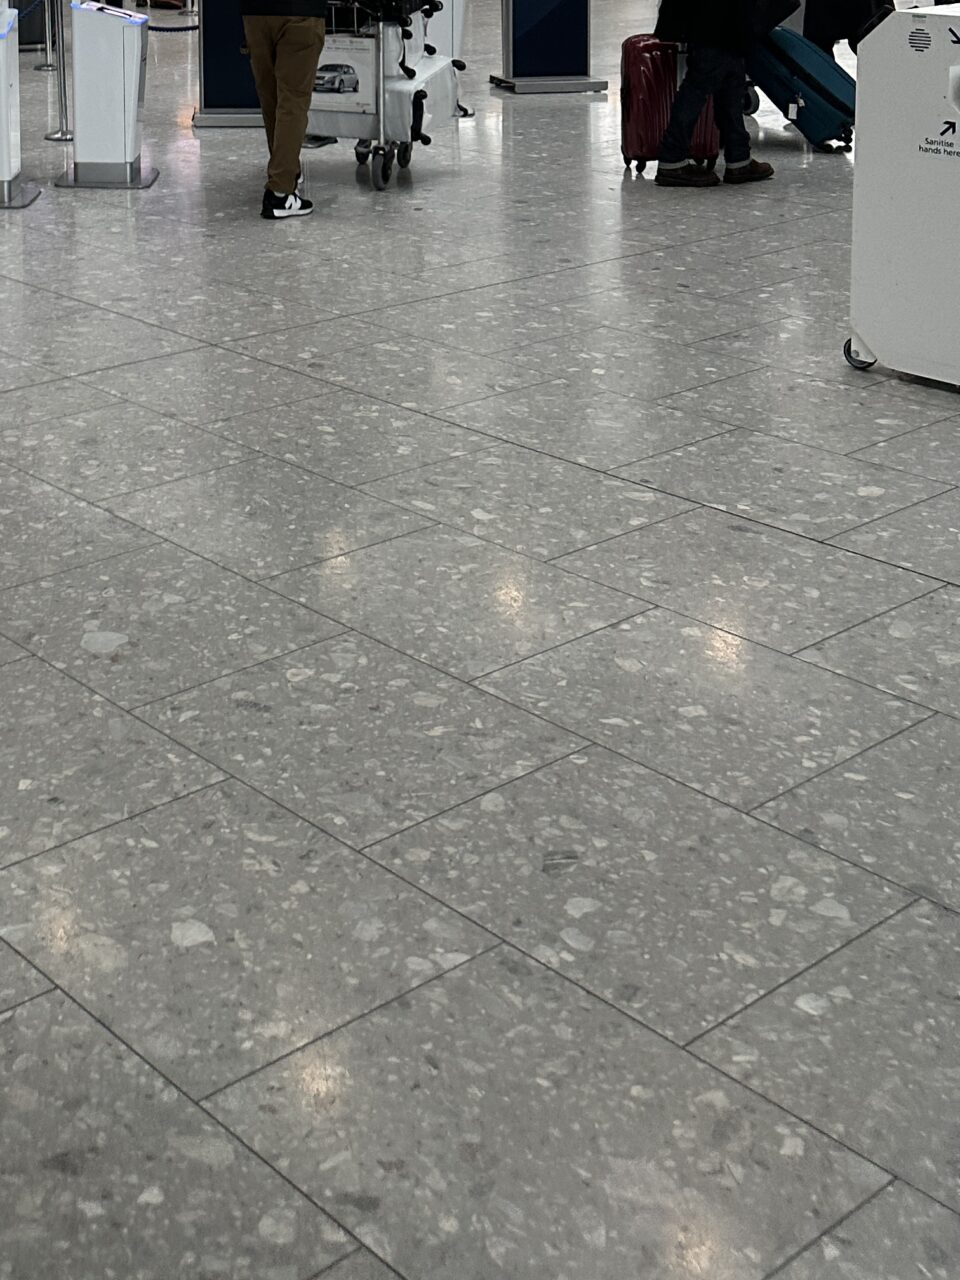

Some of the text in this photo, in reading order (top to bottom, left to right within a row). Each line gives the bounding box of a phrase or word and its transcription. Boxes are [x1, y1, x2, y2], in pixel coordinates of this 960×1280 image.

[925, 137, 954, 148] Sanitise
[918, 144, 960, 157] hands here
